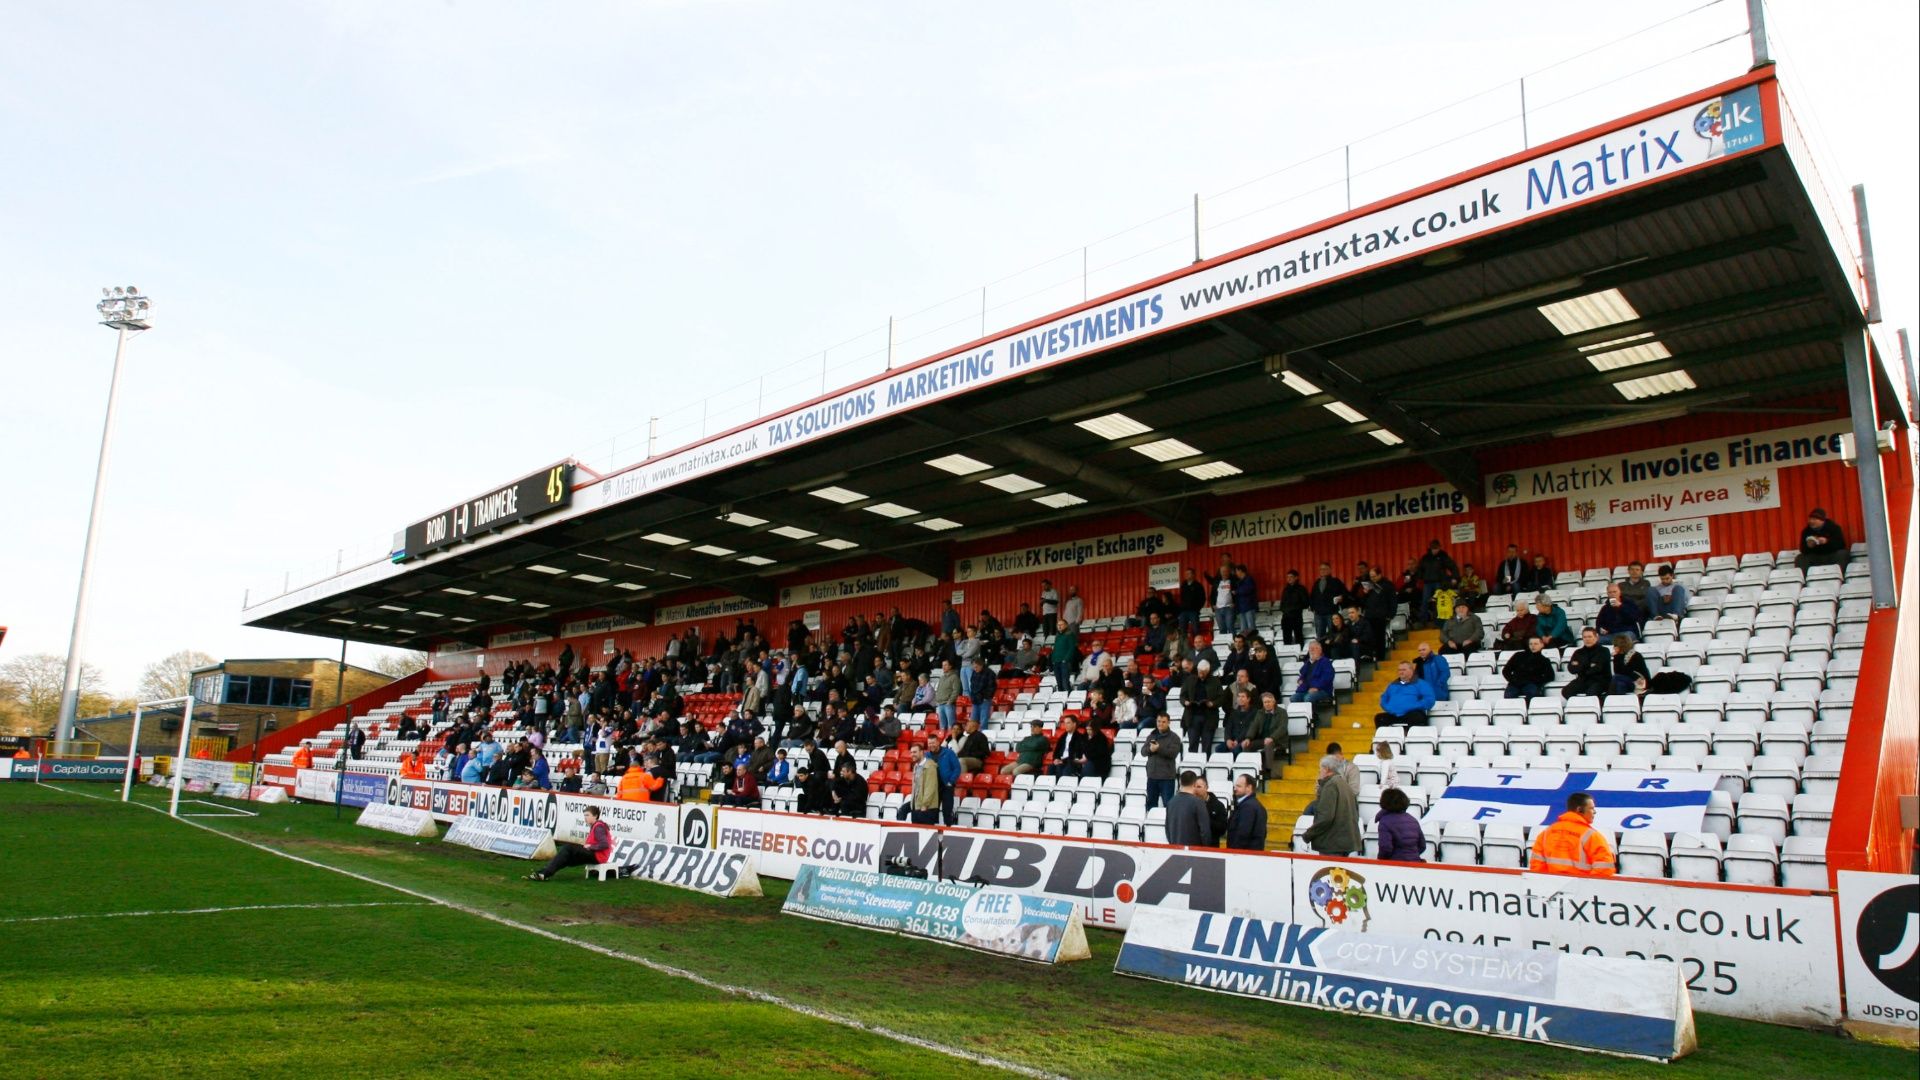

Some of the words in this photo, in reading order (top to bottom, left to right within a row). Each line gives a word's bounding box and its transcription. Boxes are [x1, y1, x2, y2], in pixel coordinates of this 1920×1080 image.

[767, 419, 793, 446] TAX
[795, 389, 876, 436] SOLUTIONS
[886, 349, 994, 408] MARKETING
[1008, 293, 1163, 368] INVESTMENTS
[1179, 188, 1501, 310] www.matrixtax.co.uk
[1525, 129, 1684, 211] Matrix
[614, 470, 649, 498] Matrix
[651, 436, 758, 484] www.matrixtax.co.uk
[1531, 464, 1614, 496] Matrix
[1621, 447, 1720, 484] Invoice
[1727, 432, 1843, 468] Finance
[426, 515, 447, 545] BORO
[474, 486, 519, 528] TRANMERE
[546, 466, 564, 504] 45
[1609, 493, 1674, 514] Family
[1680, 486, 1729, 505] Area
[1230, 513, 1288, 539] Matrix
[1288, 504, 1350, 531] Online
[1355, 488, 1464, 513] Marketing
[1658, 524, 1693, 535] BLOCK
[1696, 523, 1703, 531] E
[984, 552, 1024, 574] Matrix
[1025, 548, 1041, 567] FX
[1044, 541, 1093, 564] Foreign
[1096, 532, 1164, 555] Exchange
[1654, 542, 1679, 551] SEATS
[809, 583, 837, 600] Matrix
[838, 582, 854, 596] Tax
[856, 575, 900, 593] Solutions
[686, 601, 721, 618] Alternative
[14, 763, 38, 773] First
[52, 764, 89, 774] Capital
[1496, 774, 1523, 786] T
[1636, 777, 1670, 790] R
[401, 787, 413, 808] sky
[414, 790, 430, 807] BET
[434, 792, 447, 812] sky
[449, 794, 466, 813] BET
[565, 801, 590, 813] NORTO
[612, 807, 648, 822] PEUGEOT
[1472, 806, 1502, 821] F
[1620, 813, 1653, 830] C
[510, 826, 549, 840] SUPPORT
[617, 823, 633, 833] Dealer
[685, 819, 706, 845] JD
[719, 827, 874, 866] FREEBETS.CO.UK
[612, 839, 747, 893] FORTRUS
[818, 866, 850, 882] Walton
[851, 871, 880, 888] Lodge
[881, 873, 934, 895] Veterinary
[934, 883, 971, 901] Group
[837, 886, 854, 896] Lodge
[854, 889, 866, 898] Vets
[863, 893, 913, 912] Stevenage
[915, 900, 960, 922] 01438
[975, 893, 1014, 914] FREE
[1023, 906, 1070, 922] Vaccinations
[1375, 880, 1804, 945] www.matrixtax.co.uk
[904, 916, 929, 933] 364
[931, 922, 959, 940] 354
[964, 915, 1016, 927] Consultations
[1192, 912, 1331, 968] LINK
[1336, 942, 1408, 967] CCTV
[1412, 948, 1544, 984] SYSTEMS
[1626, 950, 1739, 996] 25
[1184, 963, 1553, 1042] www.linkcctv.co.uk
